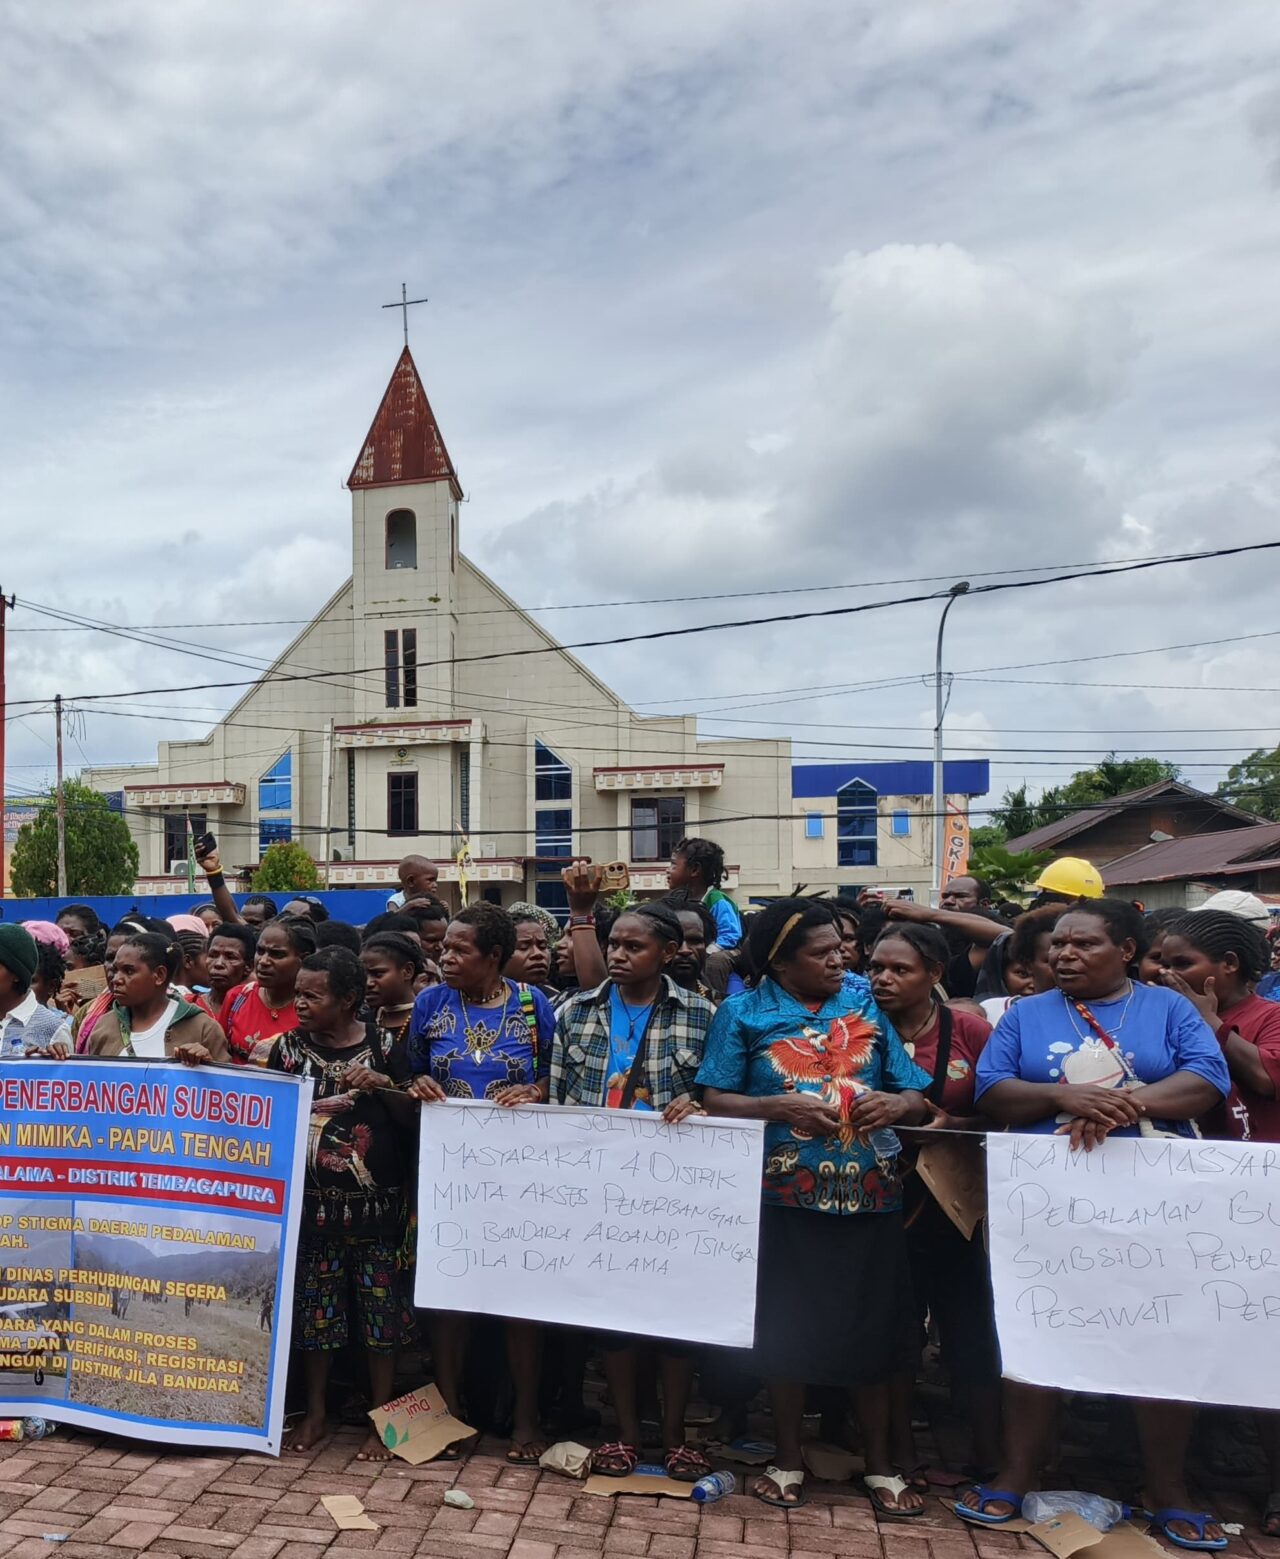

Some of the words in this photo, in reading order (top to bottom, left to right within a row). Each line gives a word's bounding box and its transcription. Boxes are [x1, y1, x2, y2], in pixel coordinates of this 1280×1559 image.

[173, 1085, 272, 1128] SUBSIDI
[16, 1123, 92, 1148] MIMIKA
[108, 1127, 175, 1154] PAPUA
[181, 1132, 271, 1166] TENGAH
[441, 1142, 608, 1173] MASYARAKAT
[620, 1150, 640, 1177] 4
[68, 1168, 137, 1187] DISTRIK
[140, 1172, 276, 1204] TEMBAGAPURA
[433, 1181, 509, 1210] MINTA
[18, 1216, 84, 1231] STIGMA
[89, 1219, 148, 1237] DAERAH
[151, 1225, 256, 1250] PEDALAMAN
[522, 1250, 575, 1272] DAN
[587, 1252, 671, 1275] ALAMA
[6, 1268, 53, 1283] DINAS
[58, 1269, 161, 1295] PERHUBUNGAN
[165, 1281, 227, 1301] SEGERA
[54, 1289, 114, 1309] SUBSIDI.
[1016, 1285, 1183, 1329] PESAWAT
[42, 1319, 85, 1335] YANG
[88, 1323, 131, 1342] DALAM
[134, 1331, 197, 1351] PROSES
[27, 1337, 60, 1351] DAN
[65, 1338, 141, 1366] VERIFIKASI,
[146, 1352, 244, 1375] REGISTRASI
[52, 1355, 67, 1369] DI
[71, 1358, 122, 1379] DISTRIK
[125, 1369, 158, 1386] JILA
[163, 1374, 240, 1394] BANDARA
